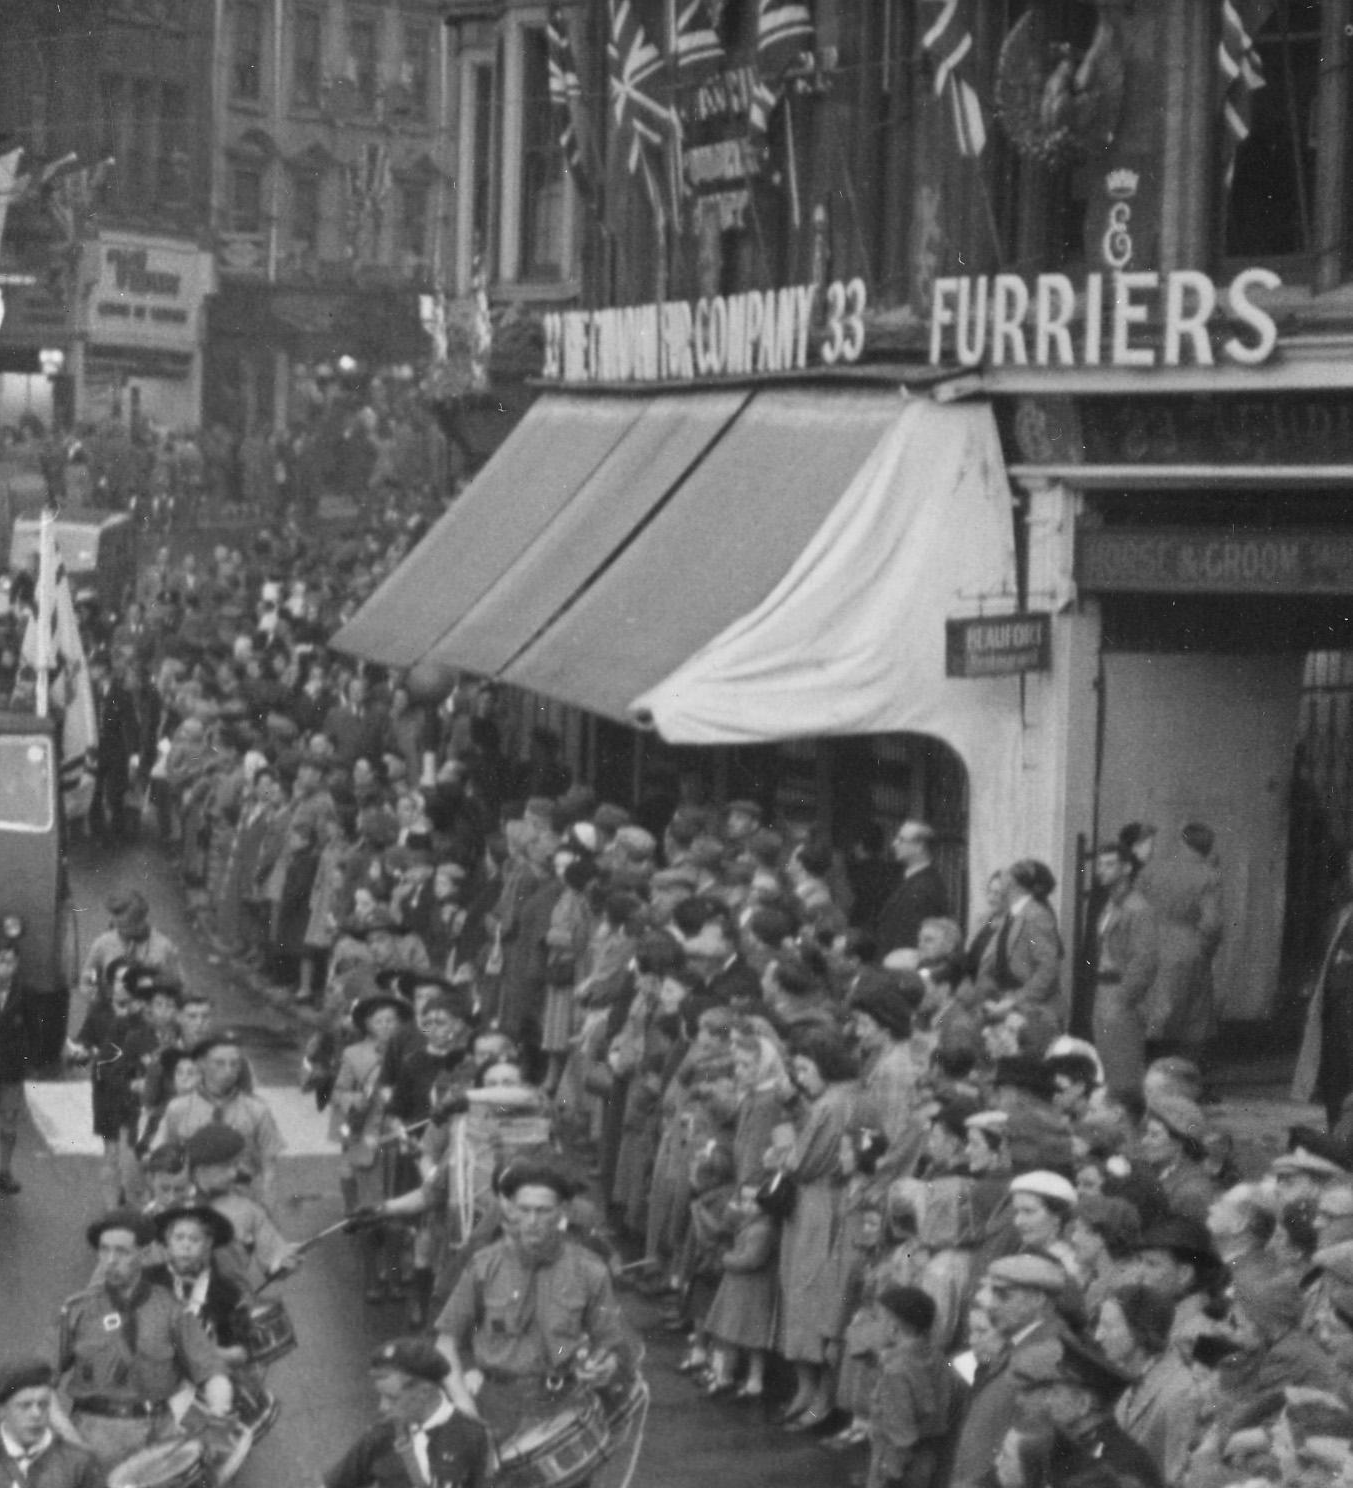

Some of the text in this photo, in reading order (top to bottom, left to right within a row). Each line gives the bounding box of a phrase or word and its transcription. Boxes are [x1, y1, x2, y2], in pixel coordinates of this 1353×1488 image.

[695, 282, 817, 374] COMPANY
[822, 277, 866, 363] 33
[929, 266, 1283, 367] FURRIERS
